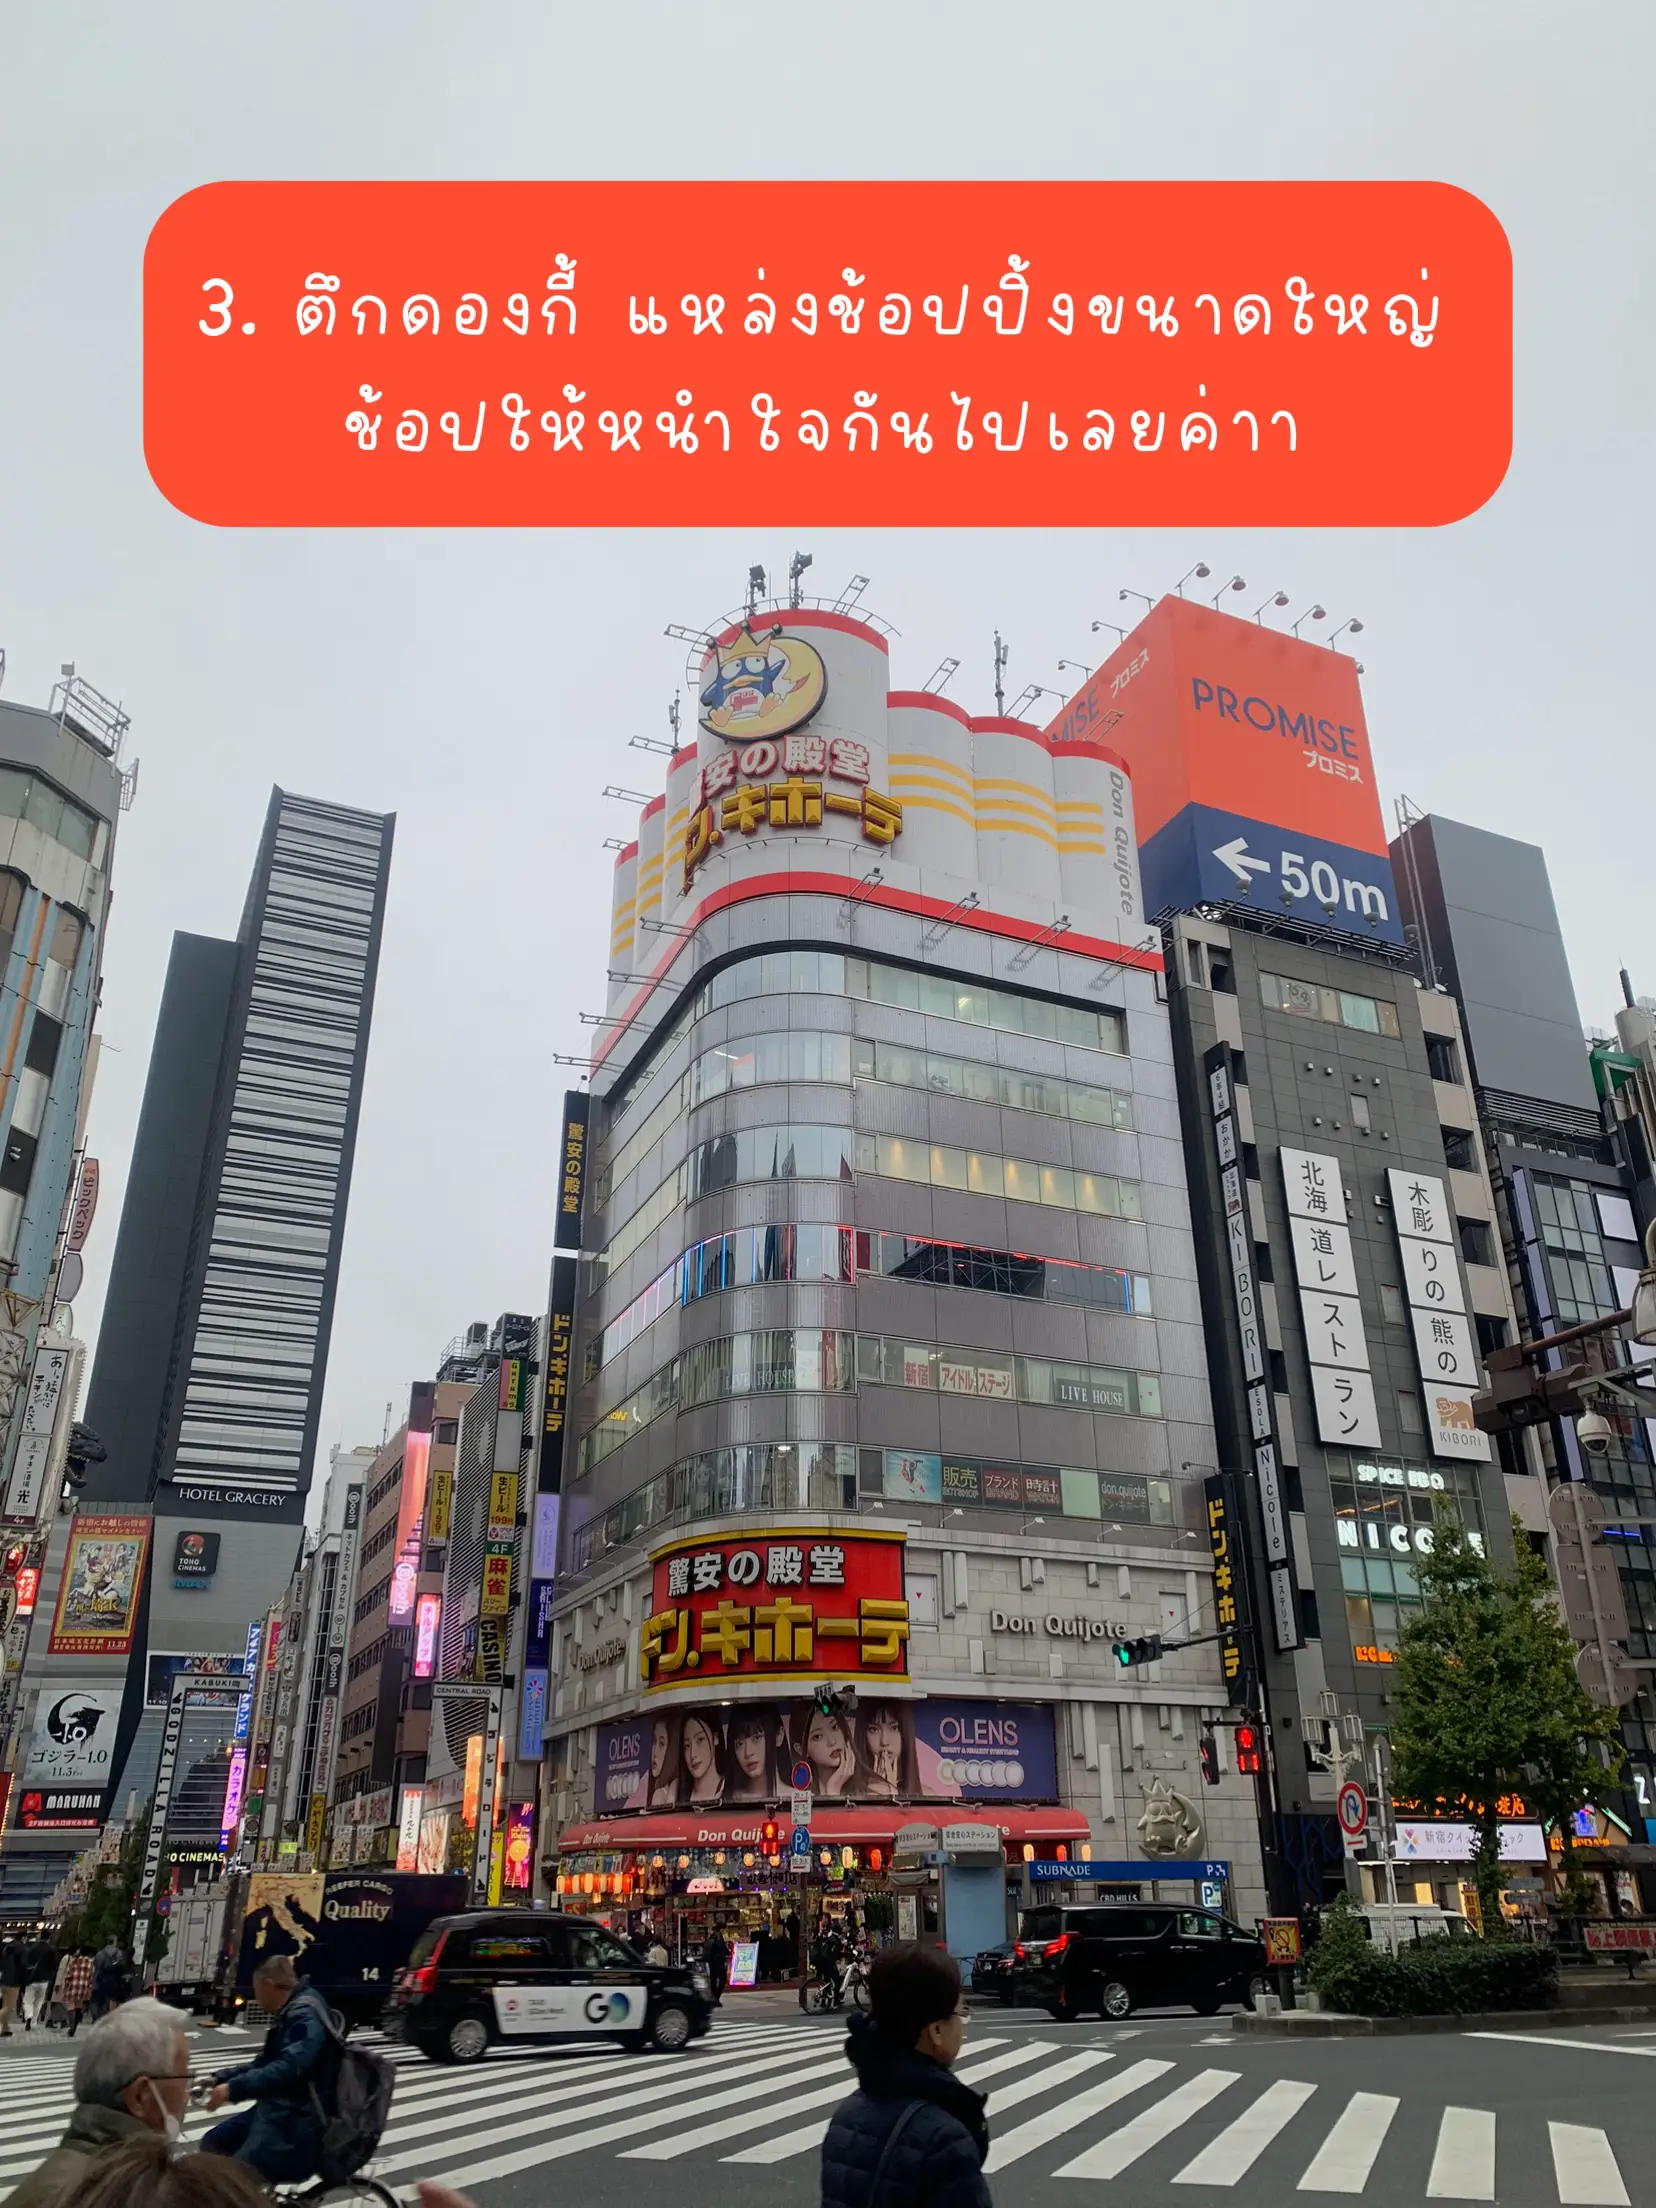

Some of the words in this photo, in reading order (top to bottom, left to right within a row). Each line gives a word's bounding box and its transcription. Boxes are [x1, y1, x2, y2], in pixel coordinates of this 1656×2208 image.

[1110, 647, 1150, 699] プロミス
[1051, 684, 1100, 742] MISE
[1191, 677, 1360, 761] PROMISE
[690, 736, 870, 808] 安の殿堂
[1302, 750, 1365, 786] プロミス
[1107, 769, 1125, 820] Don
[1111, 825, 1134, 917] Quijote
[1281, 851, 1389, 922] 50m
[1408, 1181, 1458, 1374] 木彫りの熊の
[1230, 1218, 1258, 1375] KIBORI
[1301, 1159, 1359, 1435] 北海道レストラン
[904, 1361, 930, 1387] 新宿
[941, 1366, 974, 1391] アイドル
[979, 1370, 1011, 1396] ステージ
[1060, 1384, 1088, 1403] LIVE
[1092, 1389, 1125, 1407] HOUSE
[1253, 1388, 1268, 1438] ESOLA
[1439, 1430, 1483, 1448] KIBORI
[495, 1475, 507, 1513] 生ビール
[943, 1466, 979, 1490] 販売
[984, 1474, 1019, 1490] ブランド
[1026, 1478, 1059, 1494] 時計
[1356, 1463, 1405, 1486] SPICE
[1407, 1469, 1445, 1491] BBQ
[179, 1487, 223, 1502] HOTEL
[225, 1491, 287, 1506] GRACERY
[1259, 1449, 1280, 1550] Nicole
[491, 1544, 509, 1555] 4F
[1336, 1519, 1486, 1559] NICOE
[177, 1564, 207, 1573] CINEMAS
[178, 1557, 201, 1566] TOHO
[488, 1557, 509, 1597] 麻雀
[667, 1545, 846, 1598] 驚安の殿堂
[992, 1609, 1037, 1635] Don
[1045, 1613, 1129, 1643] Quijote
[327, 1652, 342, 1689] Booth
[436, 1686, 471, 1695] CENTRAL
[472, 1687, 492, 1696] ROAD
[608, 1731, 642, 1762] OLENS
[939, 1716, 1020, 1748] OLENS
[51, 1766, 73, 1778] 11.3
[154, 1706, 182, 1813] GODZILLA
[46, 1794, 102, 1810] MARUHAN
[226, 1764, 244, 1815] カラオケ
[144, 1824, 163, 1878] ROAD
[697, 1828, 728, 1843] Don
[730, 1827, 786, 1847] Quije
[179, 1852, 225, 1864] CINEMAS
[1036, 1864, 1092, 1878] SUBNADE
[1206, 1864, 1215, 1876] P
[325, 1880, 361, 1895] REEFER
[362, 1880, 394, 1895] CARGO
[1203, 1886, 1213, 1905] P
[324, 1900, 393, 1922] Quality
[361, 1967, 380, 1981] 14
[583, 1991, 632, 2025] GO
